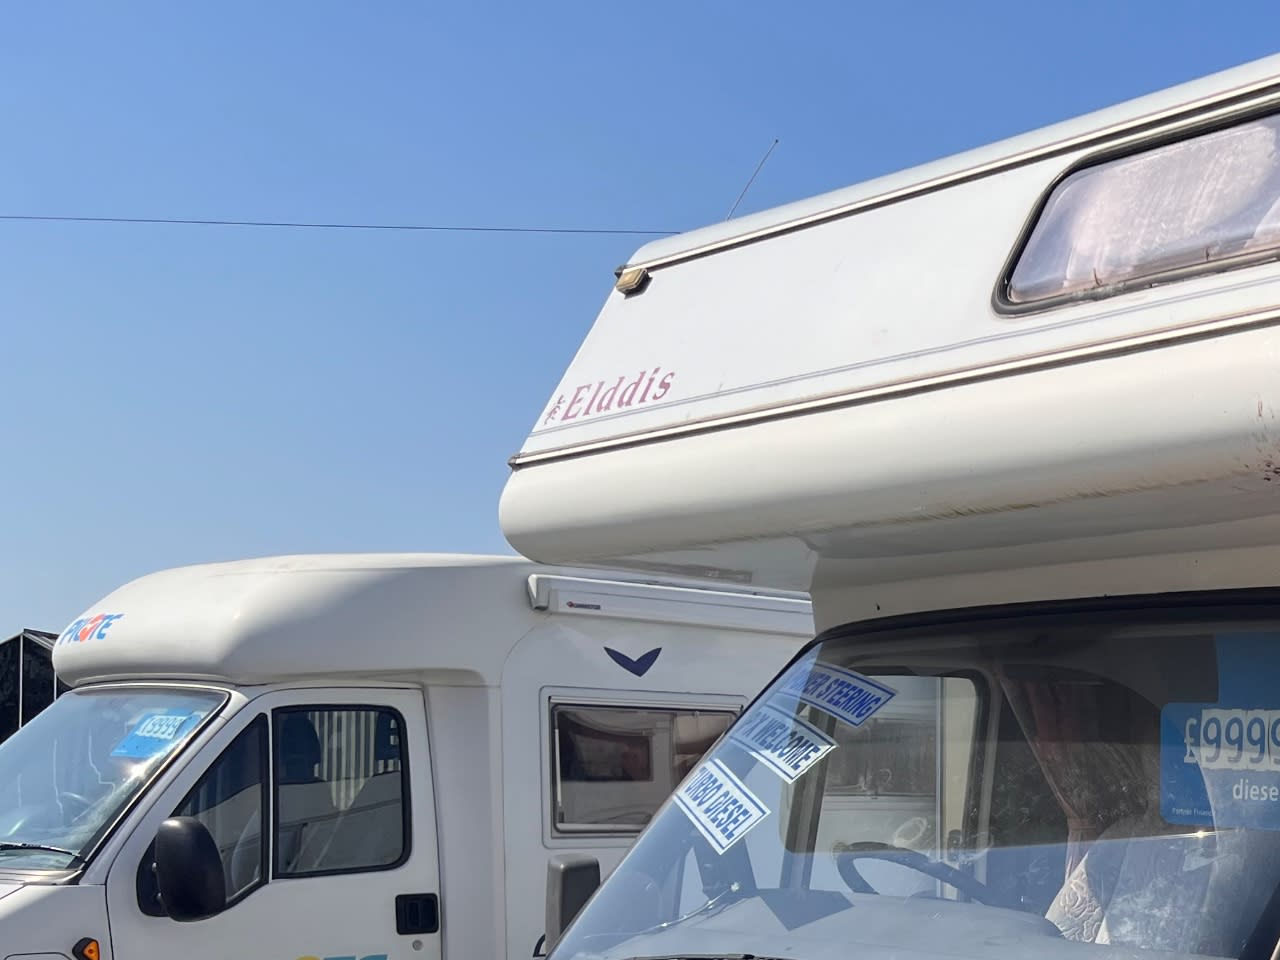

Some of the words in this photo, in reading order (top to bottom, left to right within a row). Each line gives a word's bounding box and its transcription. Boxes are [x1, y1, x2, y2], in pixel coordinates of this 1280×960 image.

[561, 367, 676, 422] Elddis
[816, 678, 882, 718] STEERING
[752, 718, 821, 771] WELCOME
[704, 791, 753, 841] DIESEL
